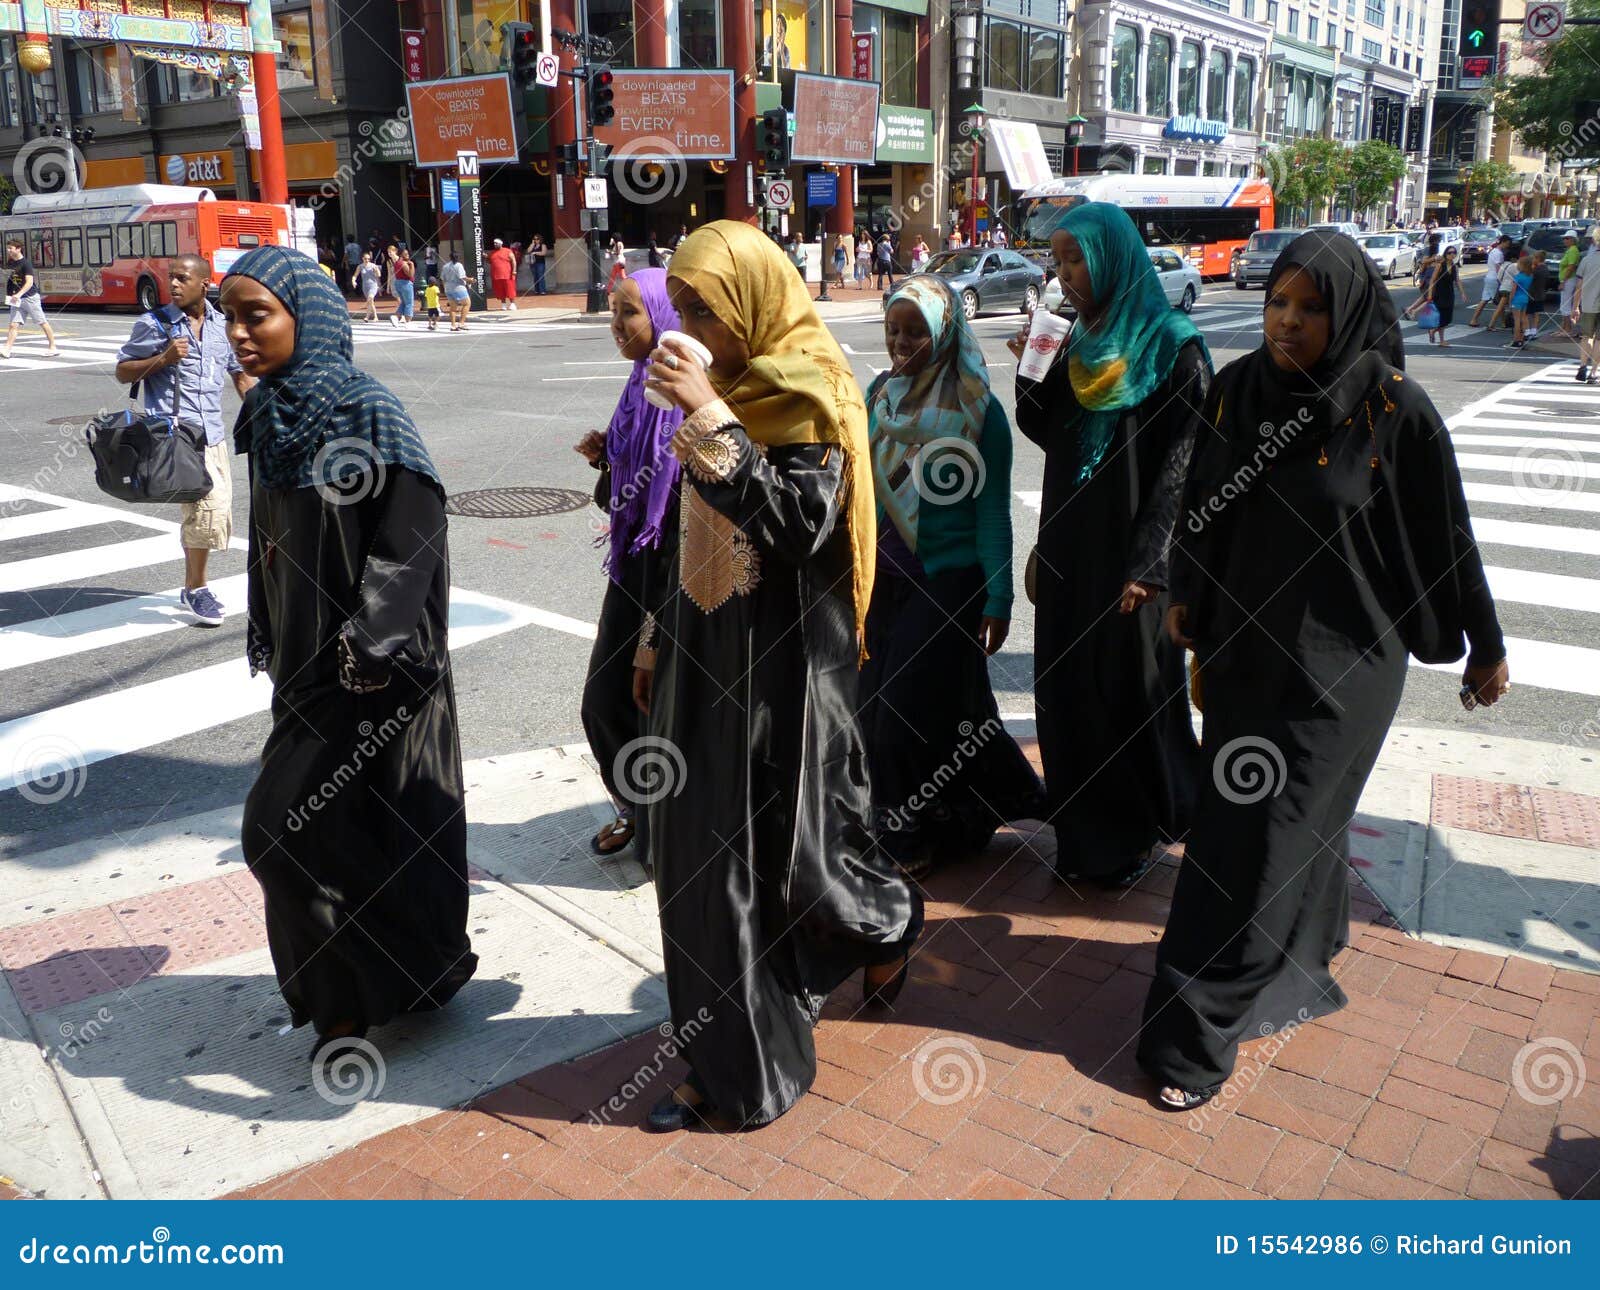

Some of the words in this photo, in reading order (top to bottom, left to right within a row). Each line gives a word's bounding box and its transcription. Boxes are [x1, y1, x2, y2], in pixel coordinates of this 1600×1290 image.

[622, 80, 696, 91] downloaded
[435, 86, 485, 101] downloaded
[641, 92, 687, 105] BEATS
[449, 98, 480, 113] BEATS
[439, 124, 474, 138] EVERY
[620, 117, 674, 131] EVERY
[816, 121, 847, 136] EVERY
[1173, 115, 1195, 133] URBAN
[1195, 118, 1229, 137] OUTFITTERS
[382, 140, 412, 150] washingt
[475, 135, 511, 152] time.
[676, 130, 725, 148] time.
[188, 155, 223, 182] at&t
[458, 156, 478, 175] M
[590, 183, 601, 192] NO
[1142, 195, 1169, 205] metrobus
[1203, 195, 1216, 205] local
[471, 187, 480, 215] Gallery
[476, 267, 485, 294] Station
